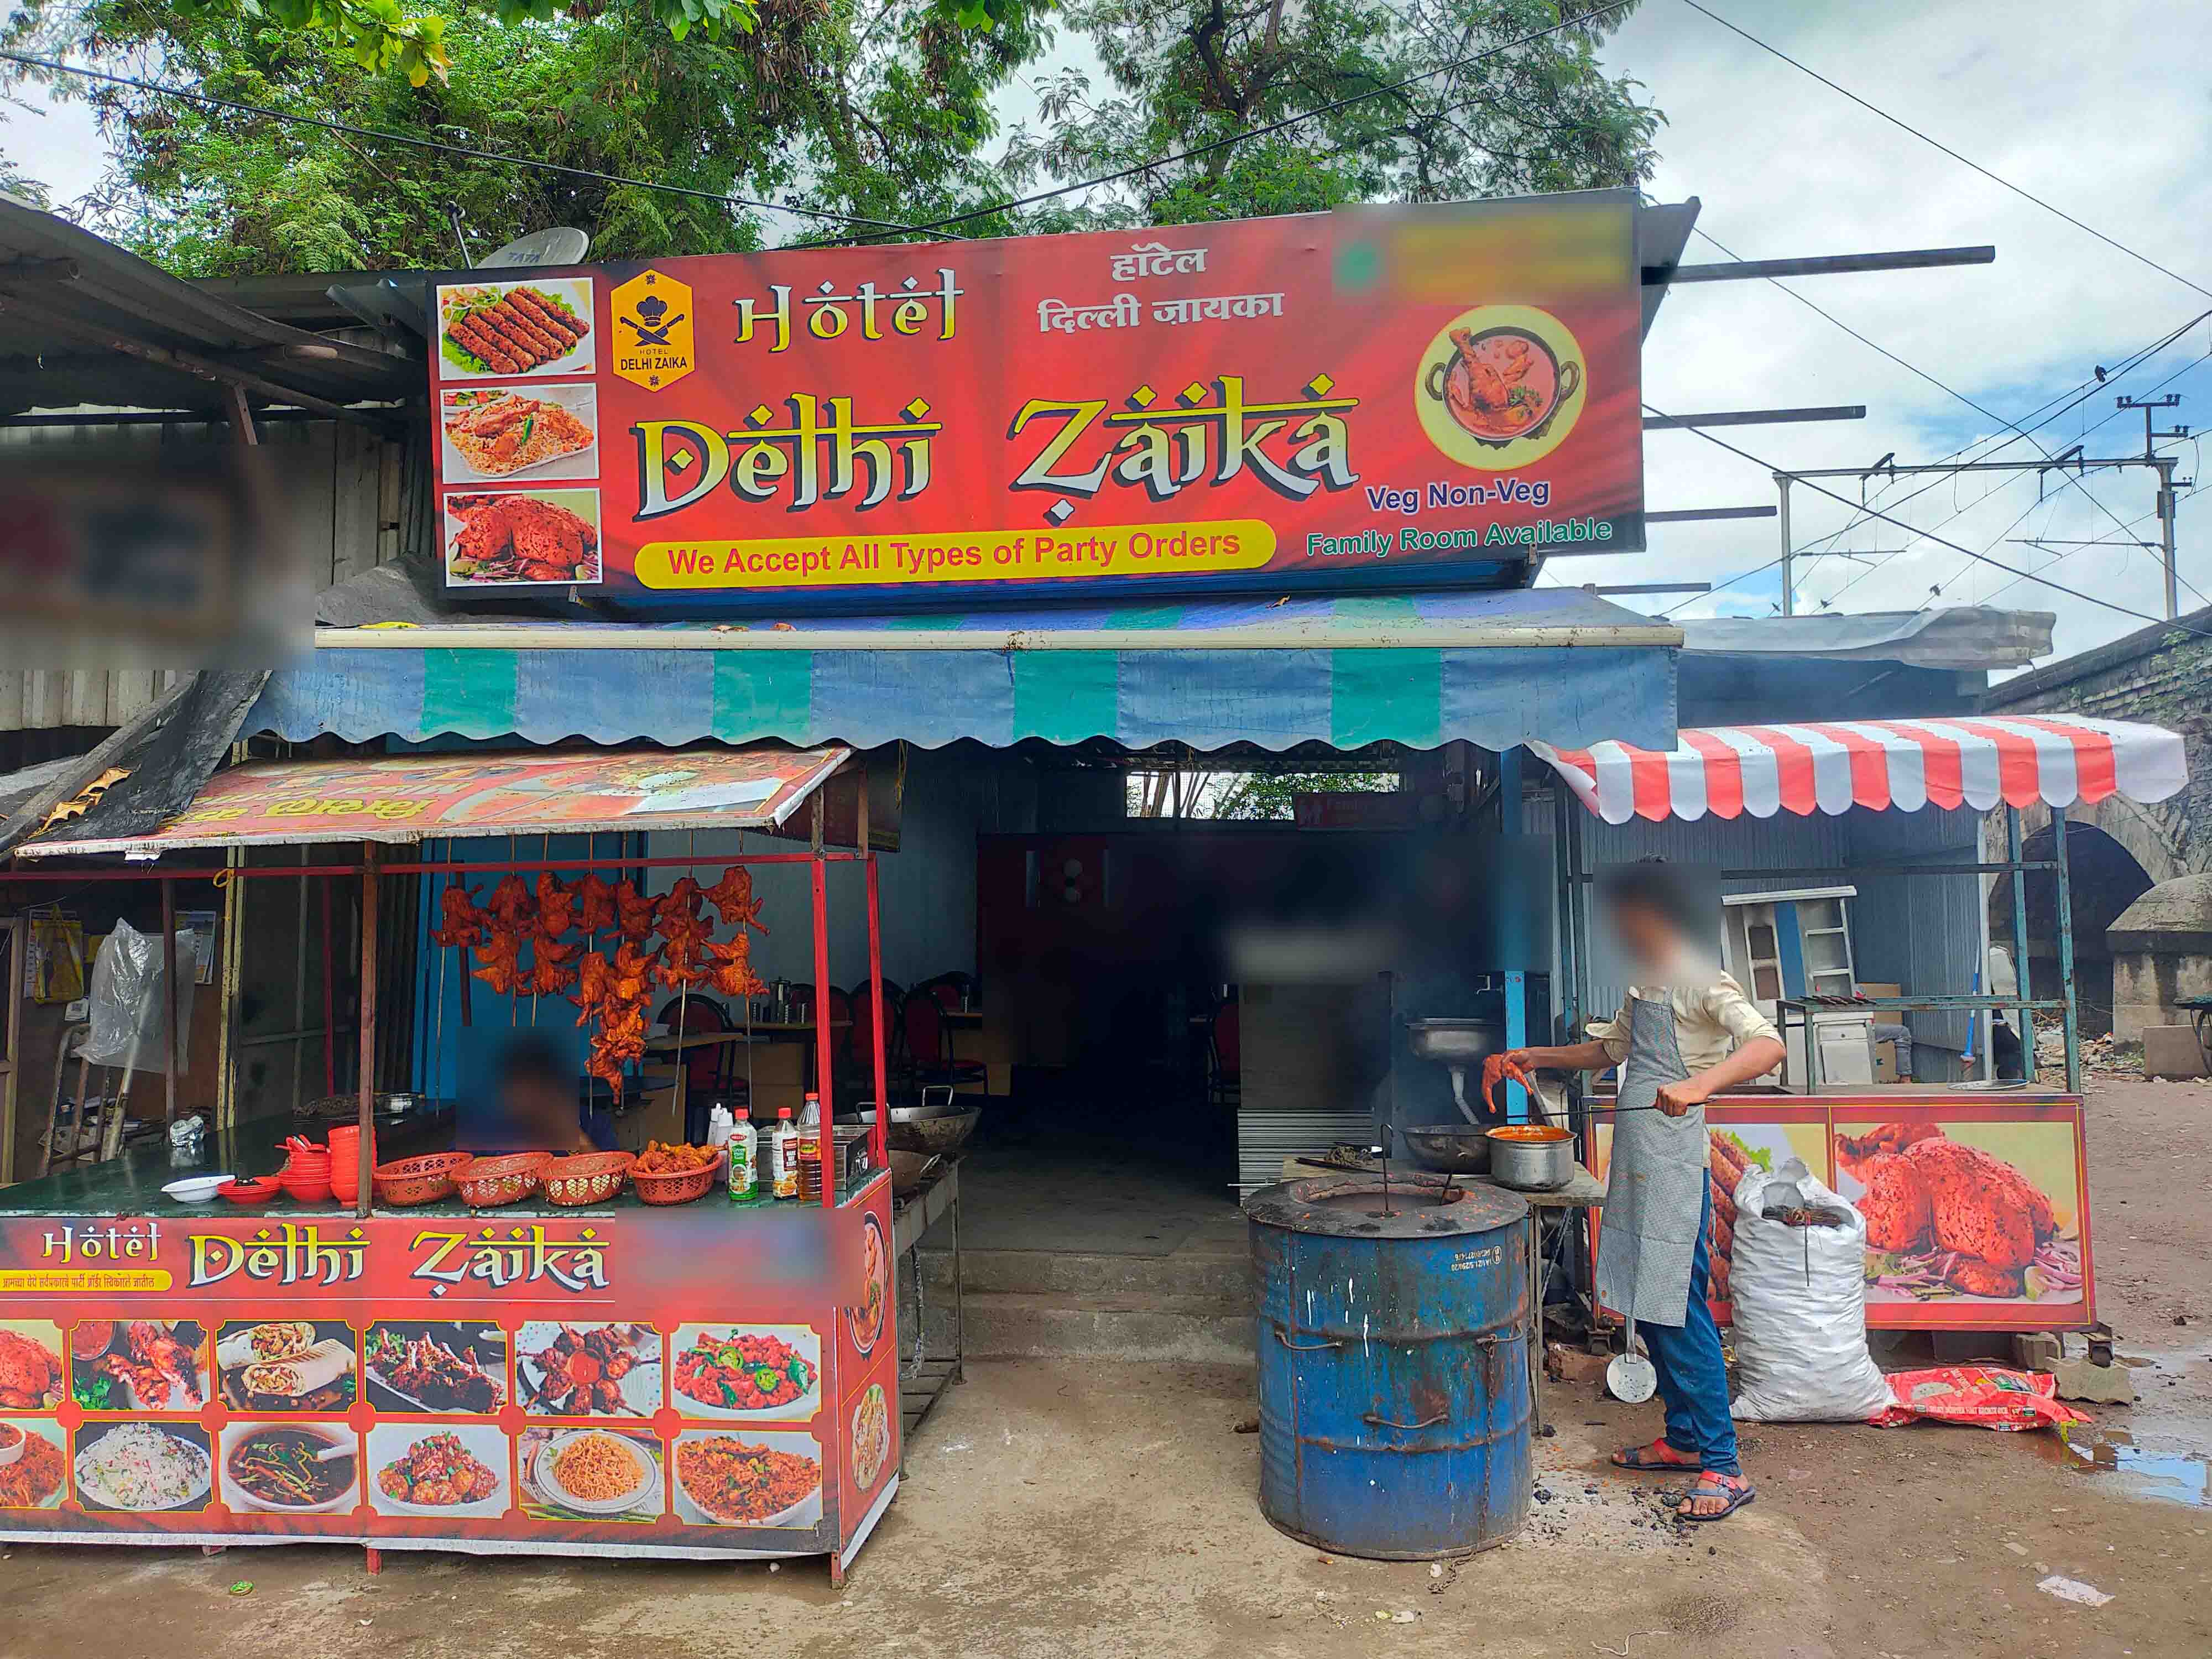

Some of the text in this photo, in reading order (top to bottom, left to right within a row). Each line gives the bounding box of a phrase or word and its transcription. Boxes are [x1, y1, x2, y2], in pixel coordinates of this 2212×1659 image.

[1110, 242, 1208, 281] हॉटेल
[735, 269, 963, 353] Hotel
[1037, 293, 1142, 333] दिल्ली
[620, 357, 687, 371] DELHI ZAIKA
[629, 373, 1360, 525] Delhi Zaika
[1367, 479, 1550, 513] Veg Non-Veg
[667, 530, 1240, 578] We Accept All Types of Party Orders
[1307, 518, 1612, 556] Family Room Available
[41, 1222, 610, 1297] Hotel Delhi Zaika
